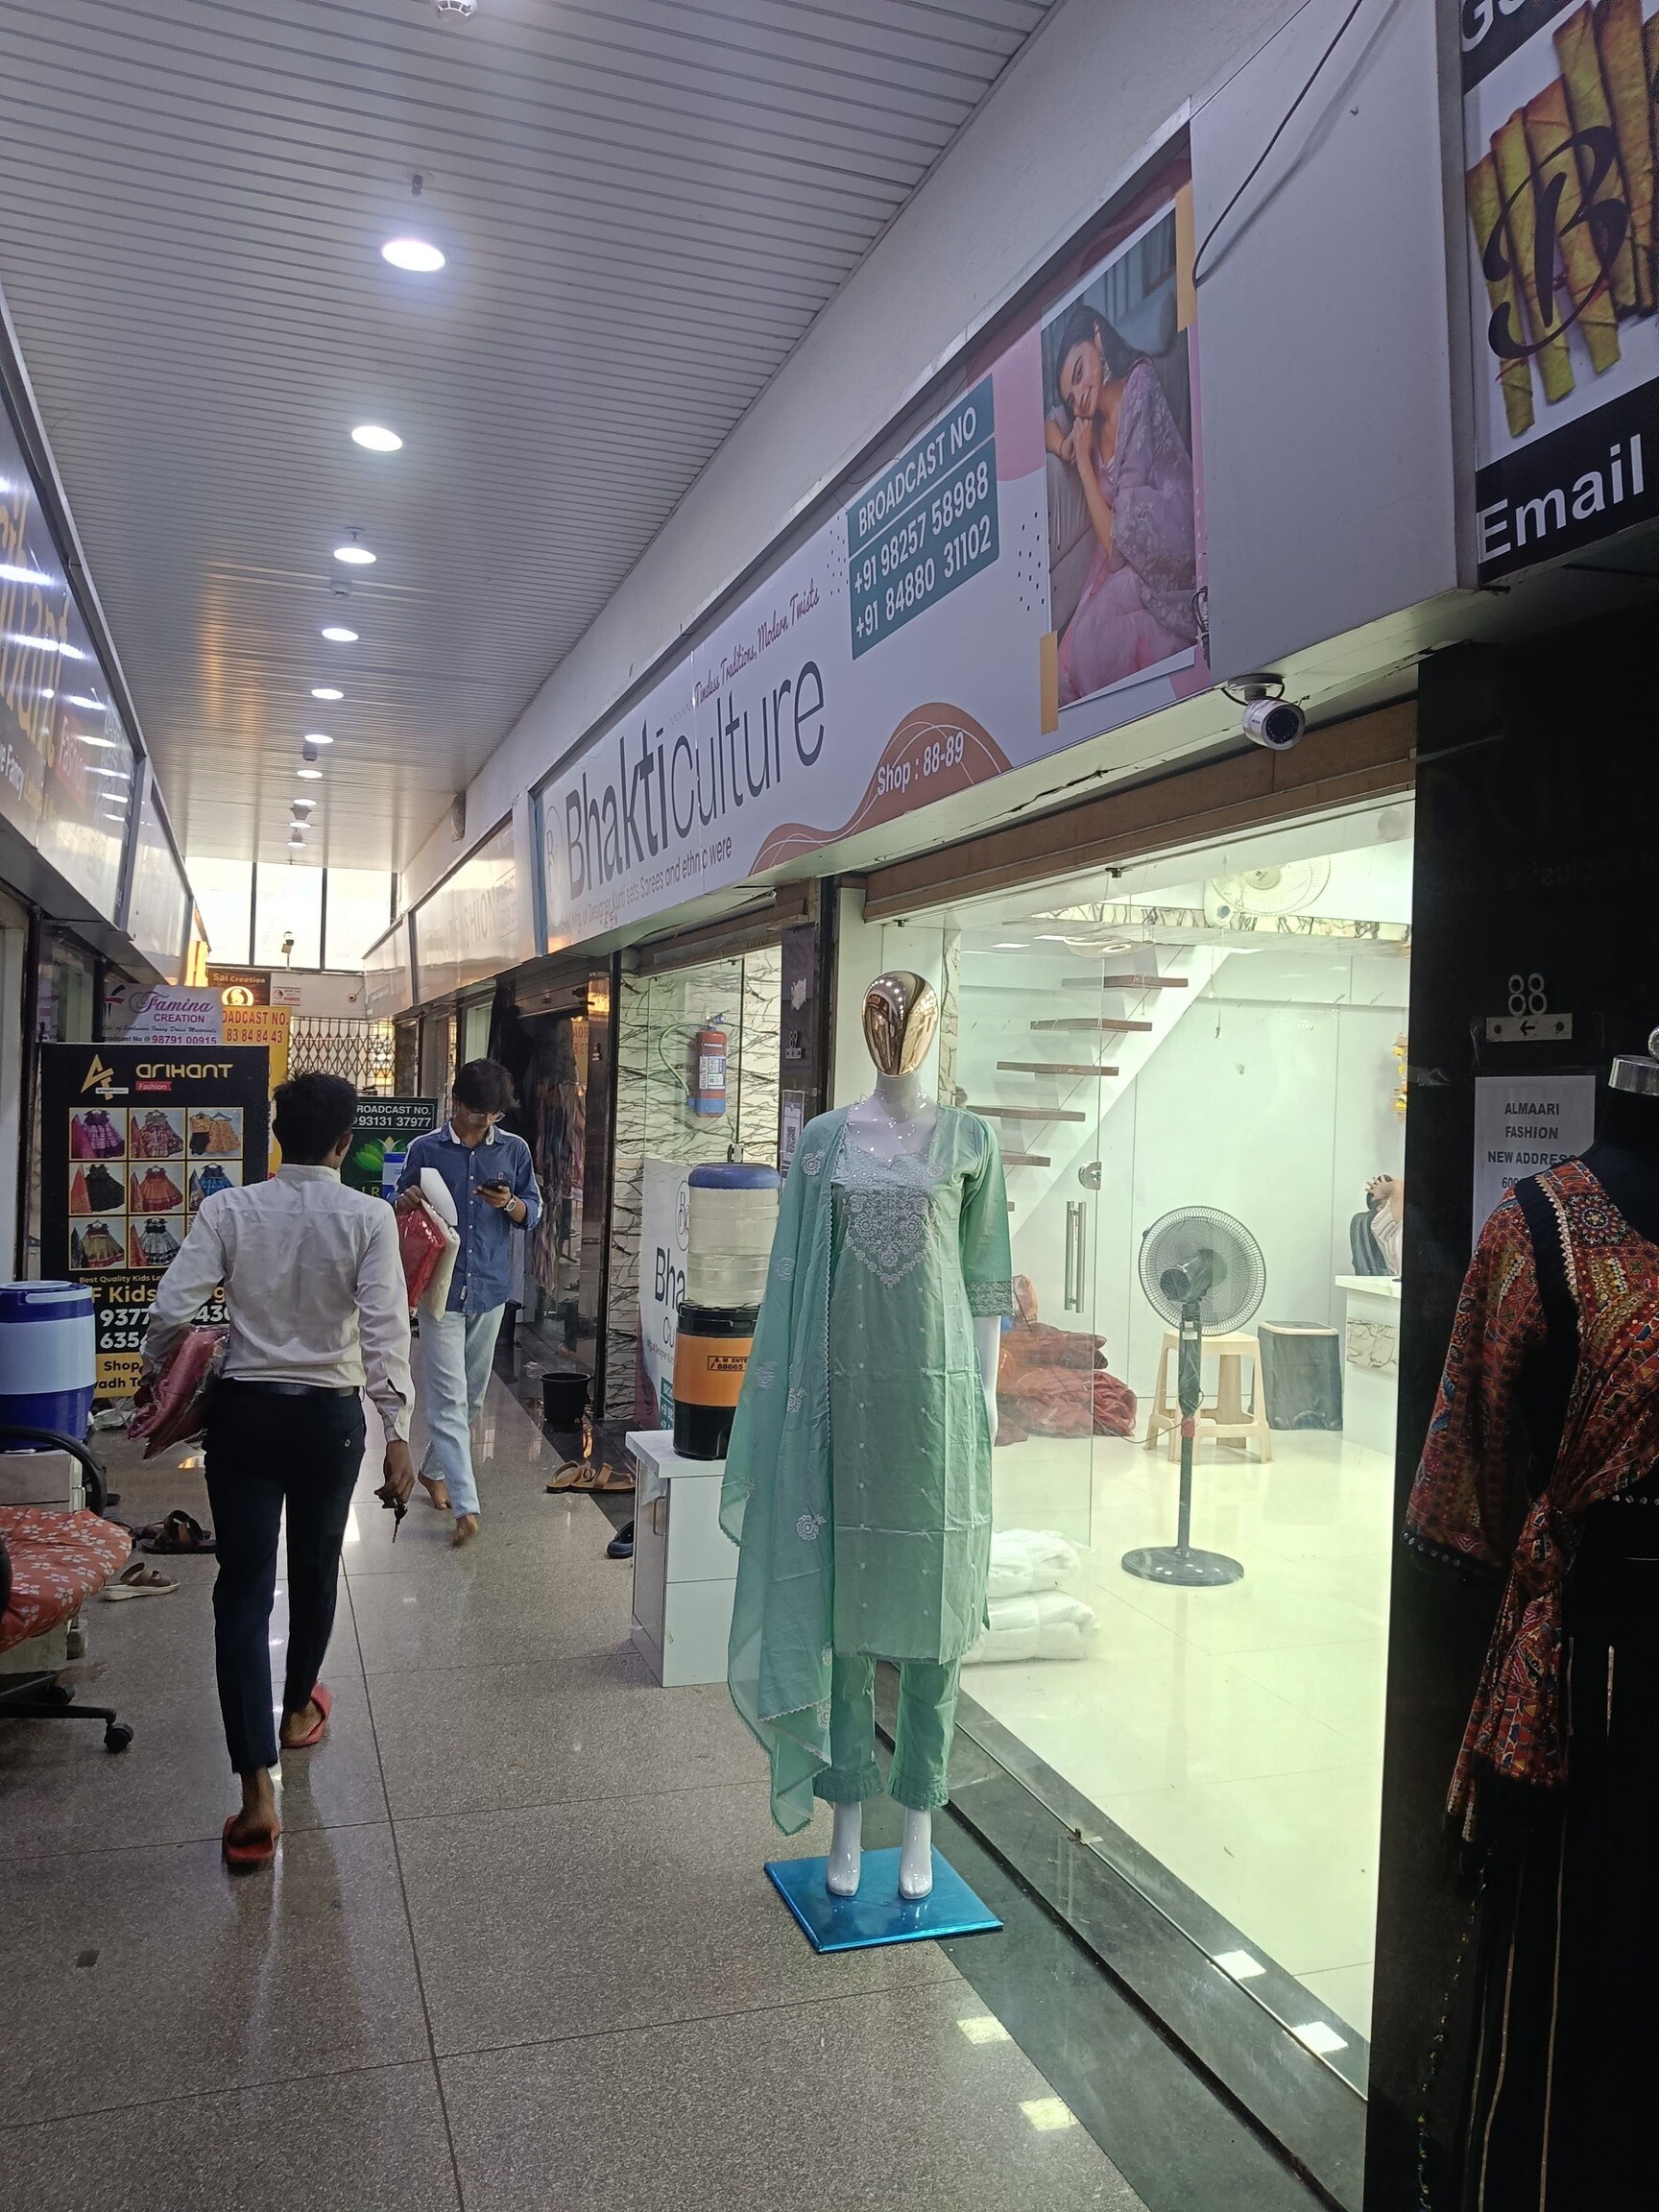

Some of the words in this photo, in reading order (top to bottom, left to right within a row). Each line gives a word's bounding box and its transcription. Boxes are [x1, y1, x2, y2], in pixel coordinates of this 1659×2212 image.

[858, 432, 946, 538] BROADCAST
[950, 406, 977, 455] NO
[1477, 434, 1646, 565] Email
[854, 554, 878, 595] +91
[880, 511, 927, 577] 98257
[931, 461, 989, 536] 58988
[855, 600, 878, 638] +91
[885, 557, 935, 622] 84880
[943, 515, 992, 579] 31102
[790, 578, 820, 626] Twists
[877, 761, 911, 796] Shop
[923, 731, 964, 777] 88-89
[639, 871, 663, 899] Sarees
[664, 857, 680, 889] and
[682, 848, 708, 880] ethnc
[709, 836, 733, 864] were
[213, 973, 228, 982] Sai
[230, 975, 266, 984] Creation
[129, 990, 215, 1014] Famina
[1508, 973, 1548, 1016] 88
[154, 1013, 205, 1023] CREATION
[272, 1012, 288, 1026] NO.
[152, 1035, 182, 1045] 98791
[186, 1036, 217, 1045] 00915
[227, 1028, 238, 1043] 83
[241, 1029, 252, 1043] 84
[256, 1029, 268, 1044] 84
[271, 1030, 283, 1044] 43
[138, 1082, 167, 1091] Fashion
[414, 1106, 432, 1116] NO.
[1504, 1102, 1560, 1116] ALMAARI
[358, 1116, 393, 1127] 93131
[396, 1117, 432, 1128] 37977
[1505, 1125, 1559, 1140] FASHION
[1487, 1150, 1514, 1164] NEW
[1516, 1151, 1576, 1166] ADDRES
[99, 1275, 131, 1285] Quality
[104, 1359, 139, 1373] Shop
